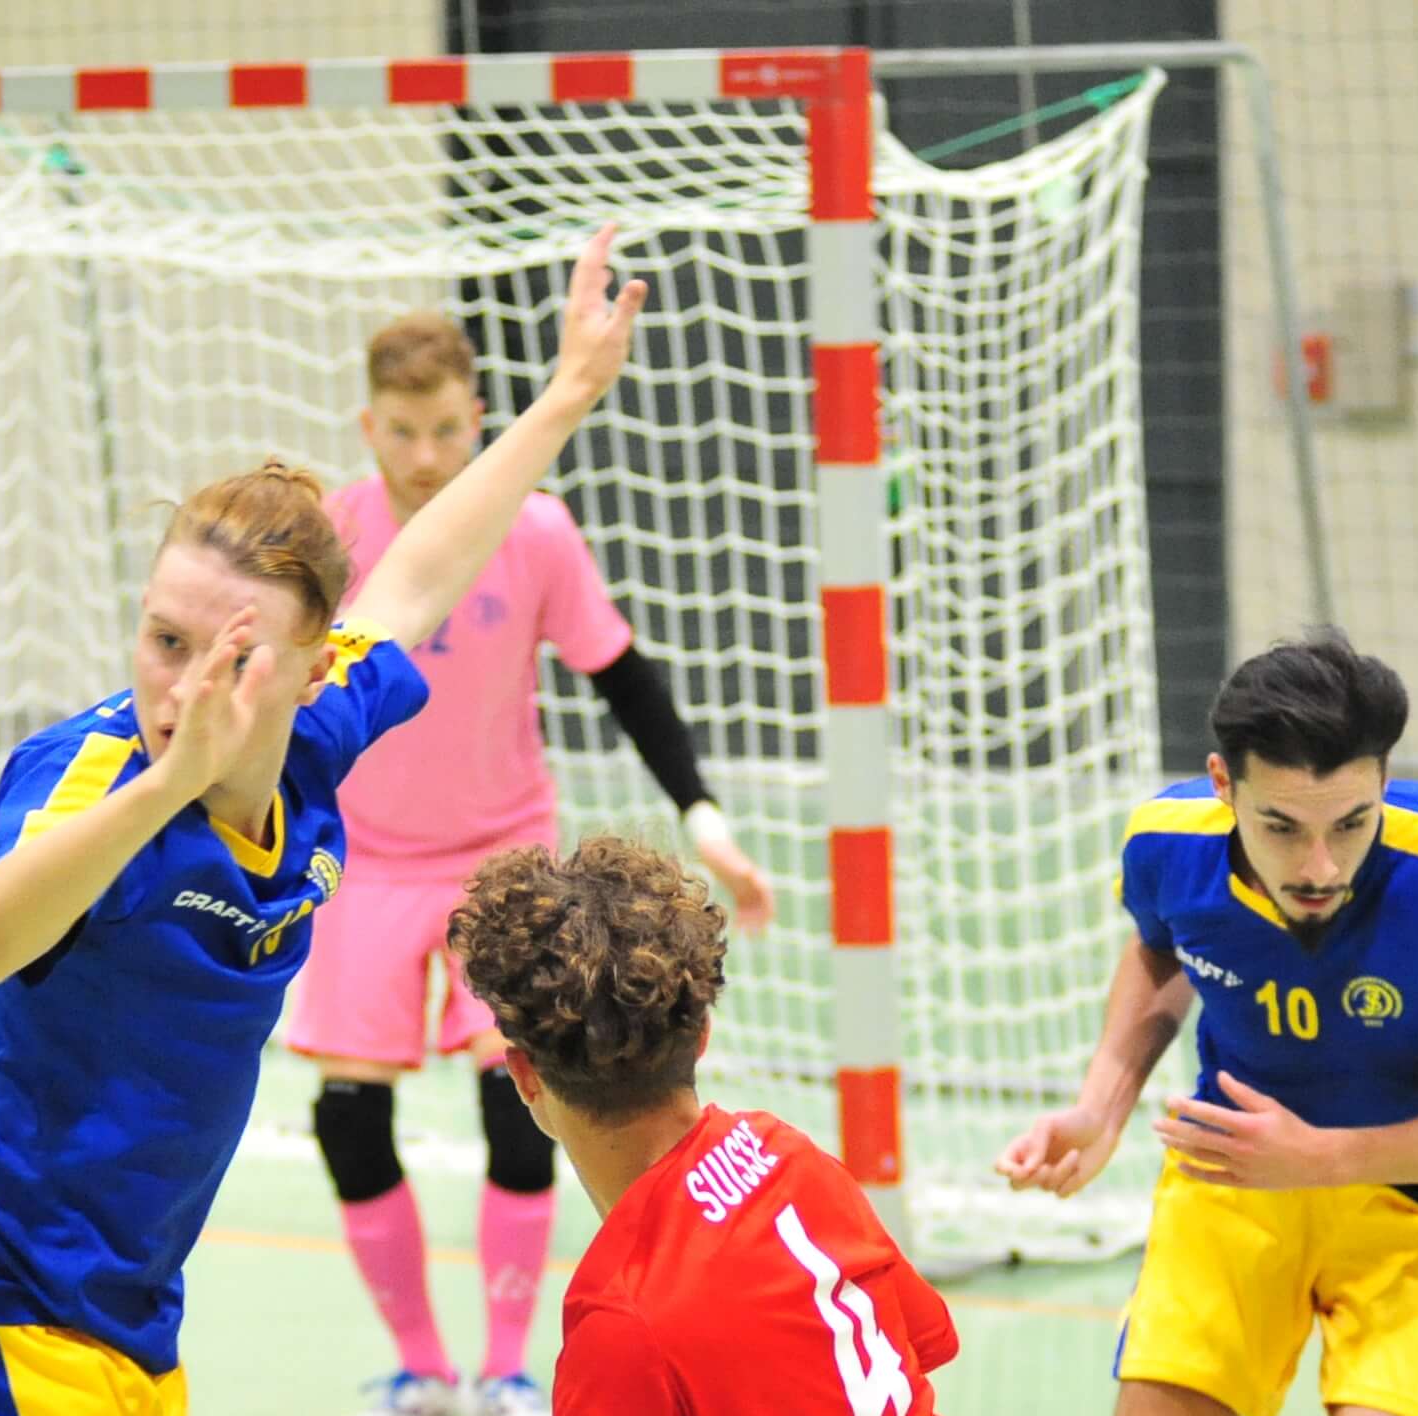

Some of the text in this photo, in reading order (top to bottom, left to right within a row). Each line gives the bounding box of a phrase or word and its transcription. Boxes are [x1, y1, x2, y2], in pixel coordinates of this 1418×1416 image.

[173, 890, 257, 928] CRAFT
[1255, 979, 1319, 1040] 10
[685, 1119, 779, 1223] SUISSE
